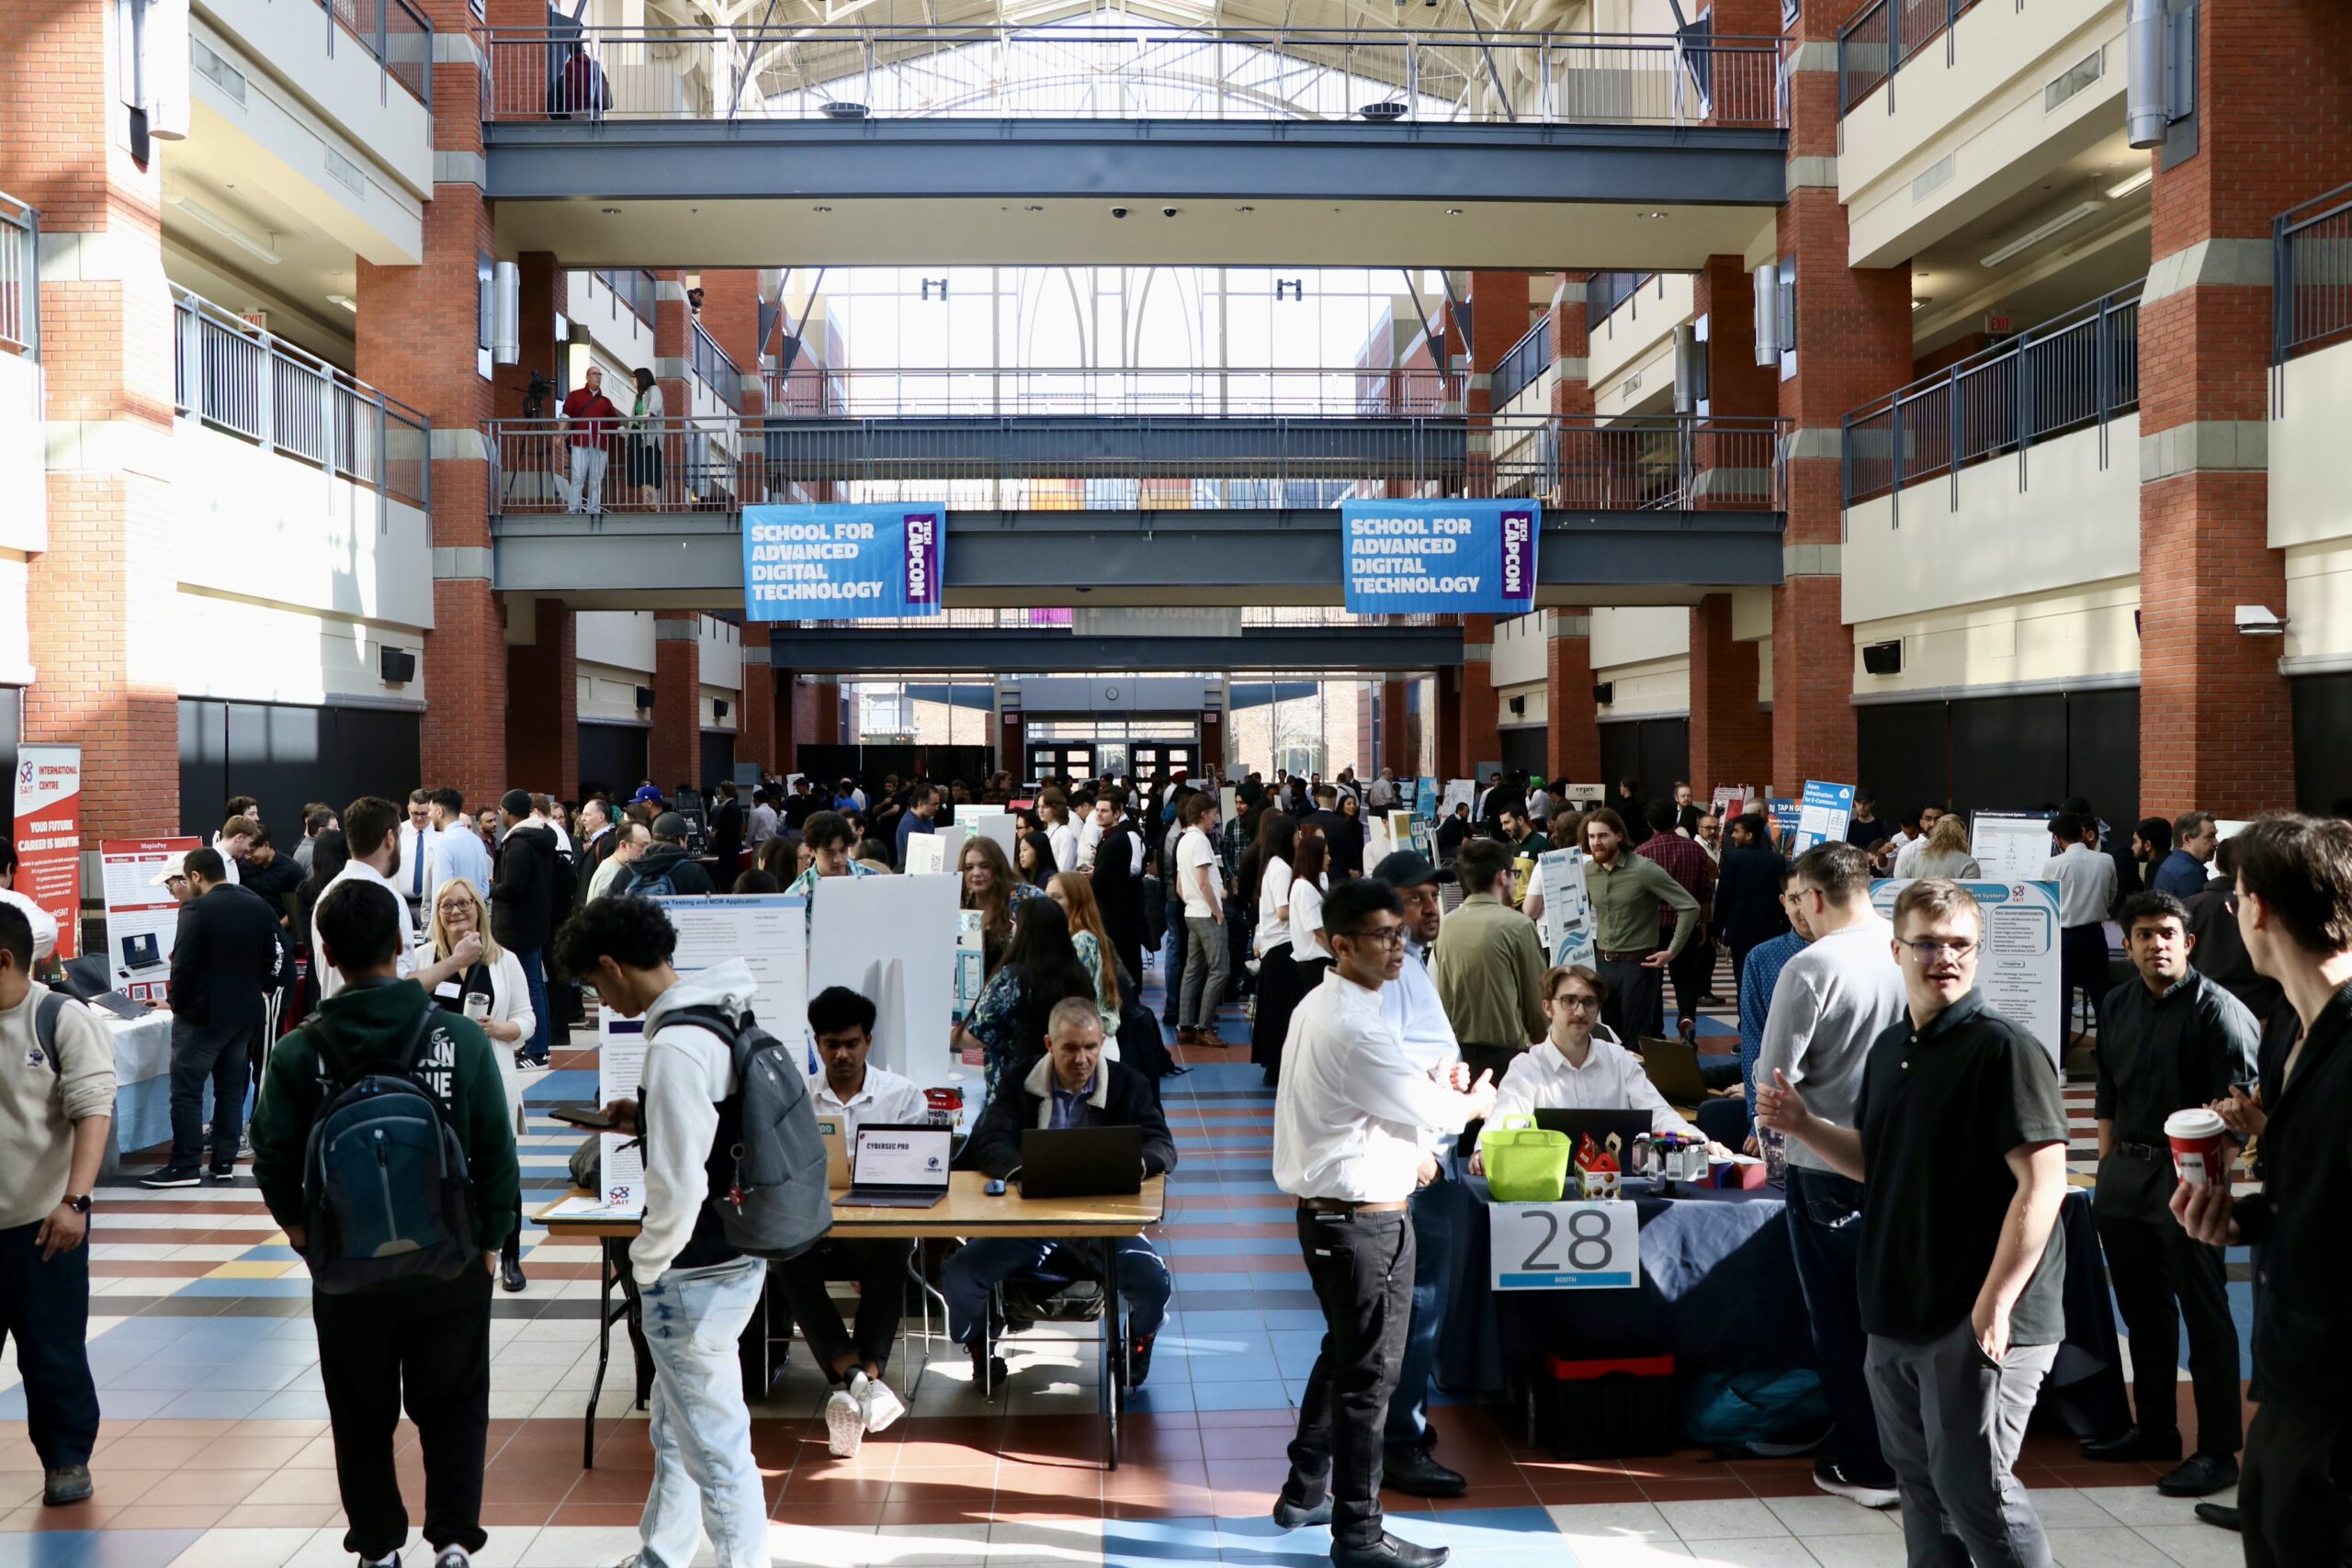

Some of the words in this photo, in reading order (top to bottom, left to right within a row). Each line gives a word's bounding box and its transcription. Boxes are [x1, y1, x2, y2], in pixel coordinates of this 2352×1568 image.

[243, 314, 262, 330] EXIT
[1991, 317, 2009, 332] EXIT
[752, 524, 831, 542] SCHOOL
[834, 523, 874, 540] FOR
[922, 520, 933, 546] TECH
[1351, 518, 1429, 536] SCHOOL
[1432, 518, 1471, 535] FOR
[1519, 517, 1528, 542] TECH
[752, 543, 859, 561] ADVANCED
[1351, 538, 1456, 555] ADVANCED
[1505, 517, 1521, 592] CAPCON
[908, 521, 925, 596] CAPCON
[1352, 558, 1426, 574] DIGITAL
[752, 563, 828, 581] DIGITAL
[752, 581, 884, 601] TECHNOLOGY
[1352, 576, 1481, 593] TECHNOLOGY
[39, 765, 77, 775] INTERNATIONAL
[19, 785, 33, 795] SAIT
[39, 781, 59, 790] CENTRE
[1806, 783, 1819, 791] Azure
[1805, 790, 1834, 798] Infrastructure
[1811, 797, 1838, 807] E-Commerce
[1777, 804, 1789, 812] TAP
[29, 821, 48, 833] YOUR
[48, 819, 74, 832] FUTURE
[17, 839, 47, 852] CAREER
[47, 838, 53, 850] IS
[671, 898, 695, 907] Testing
[725, 897, 761, 906] Application
[927, 1110, 948, 1118] mbits
[897, 1143, 910, 1151] PRO
[1521, 1209, 1613, 1271] 28
